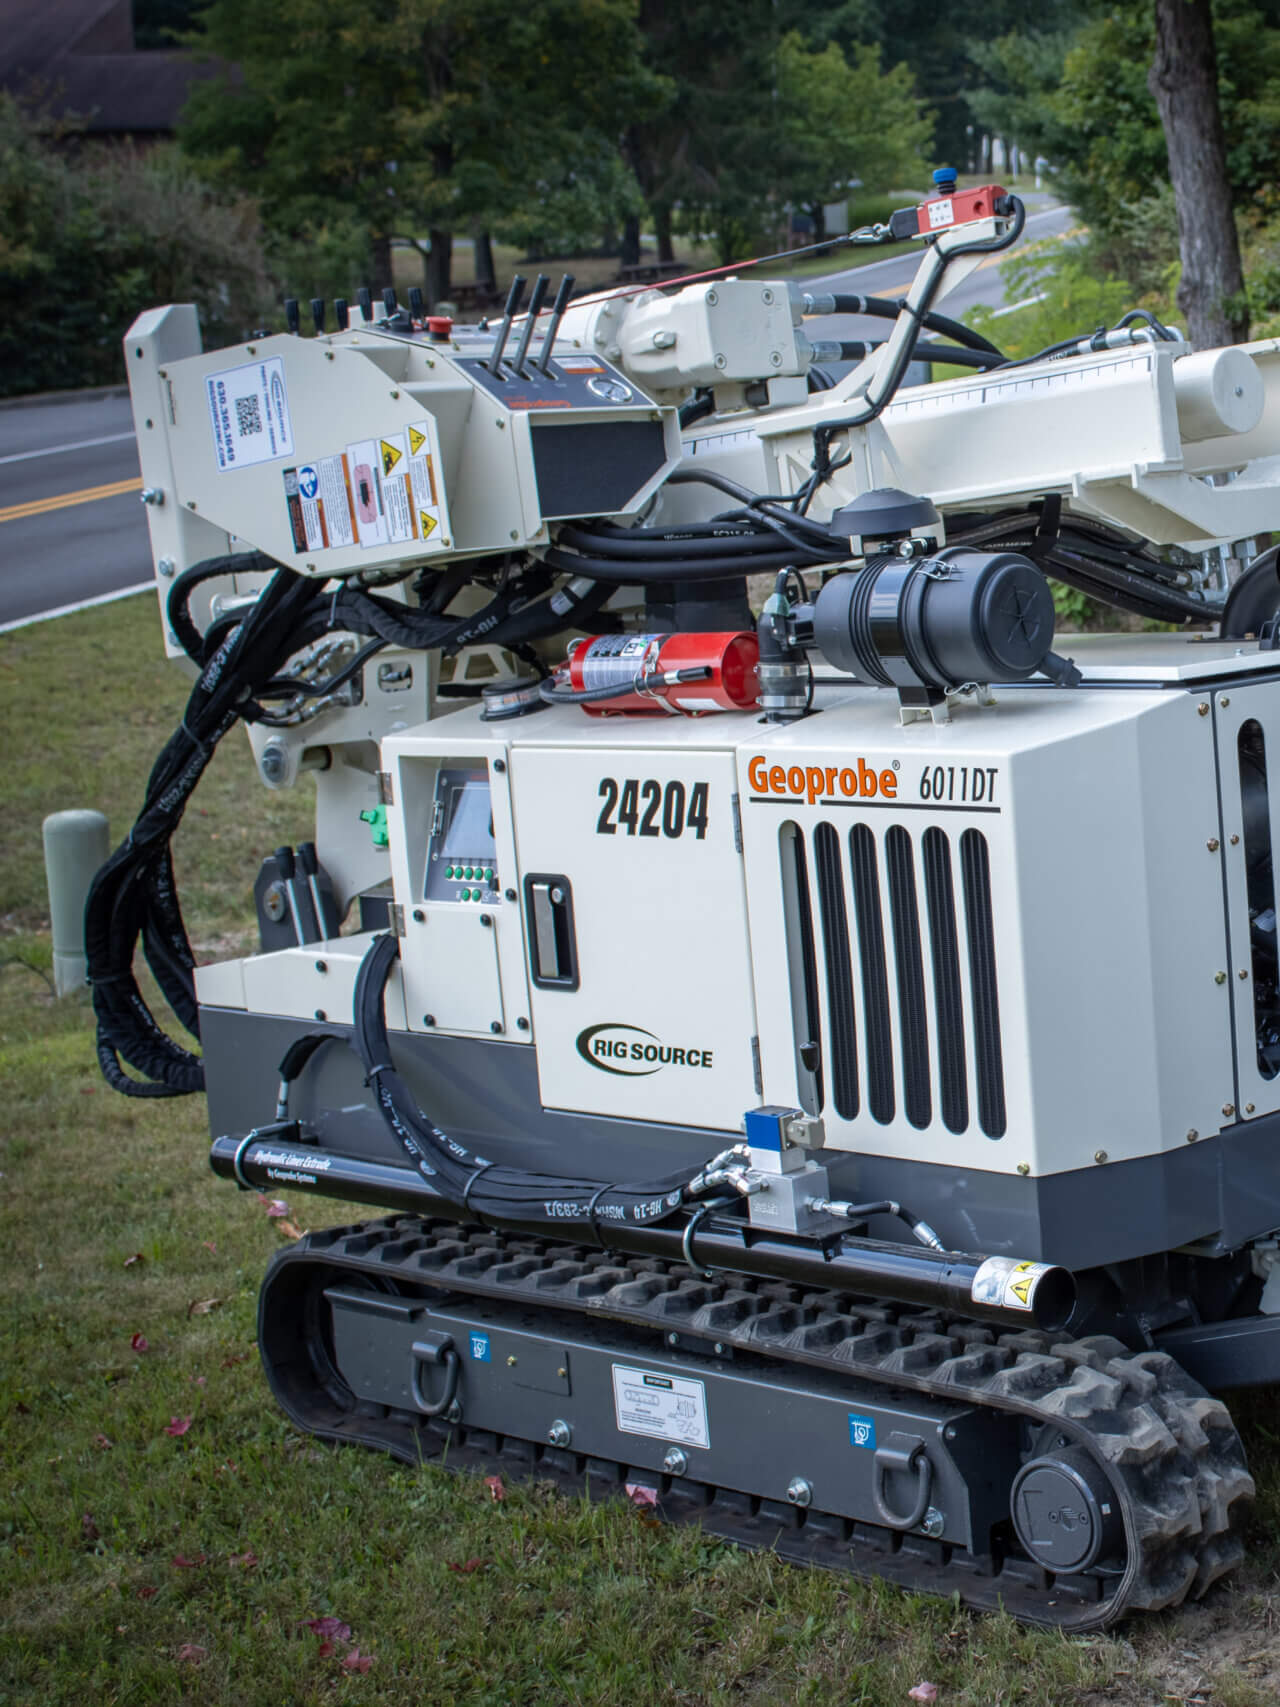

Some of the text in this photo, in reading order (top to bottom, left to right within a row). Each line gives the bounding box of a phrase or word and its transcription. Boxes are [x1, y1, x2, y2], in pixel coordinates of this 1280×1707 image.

[216, 381, 236, 462] 630.365.1649
[919, 765, 998, 802] 6011DT
[597, 778, 709, 840] 24204
[593, 1039, 713, 1068] RIG SOURCE
